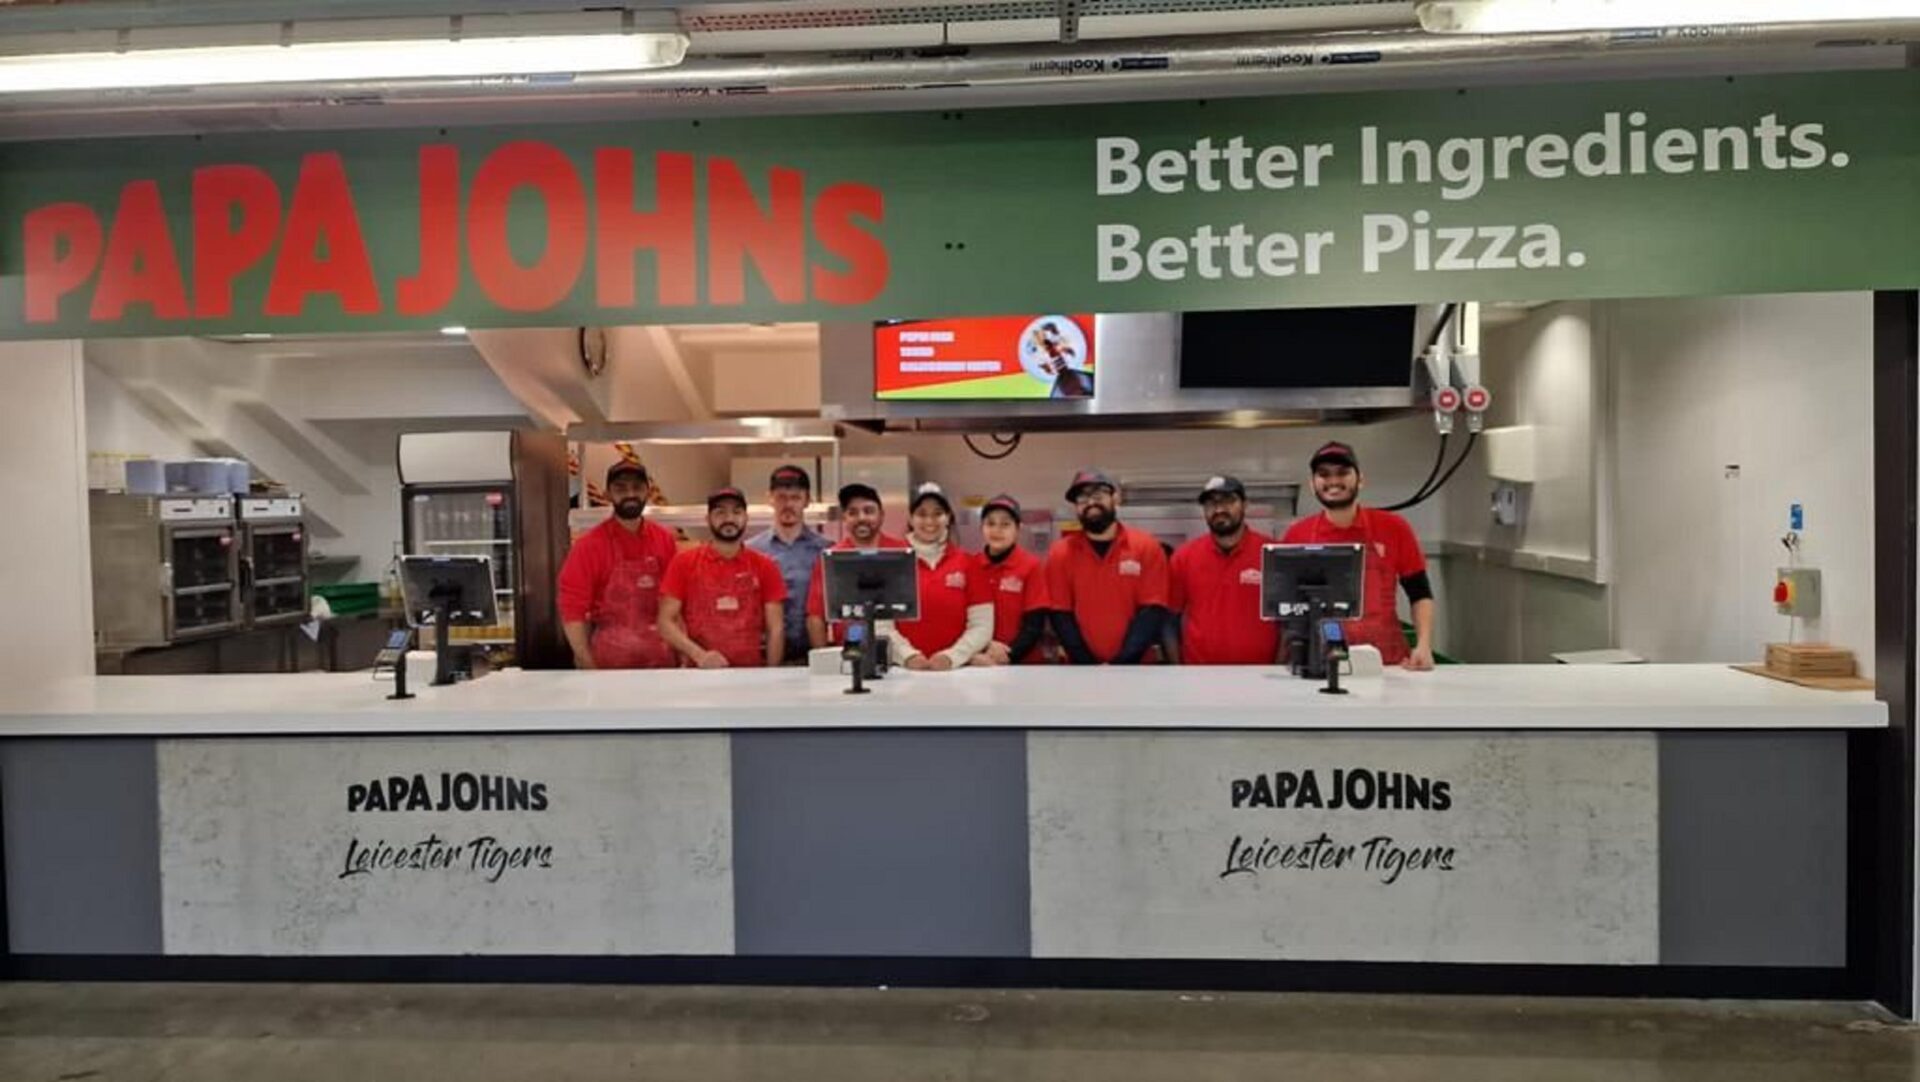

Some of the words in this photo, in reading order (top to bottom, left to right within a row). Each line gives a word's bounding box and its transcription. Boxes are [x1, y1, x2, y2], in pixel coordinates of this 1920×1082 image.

[1096, 136, 1334, 196] Better
[1361, 111, 1850, 201] Ingredients.
[1096, 222, 1335, 283] Better
[1361, 209, 1586, 274] Pizza.
[338, 833, 464, 880] Leicester
[466, 836, 553, 884] Tigers
[1219, 832, 1357, 879] Leicester
[1361, 836, 1457, 885] Tigers
